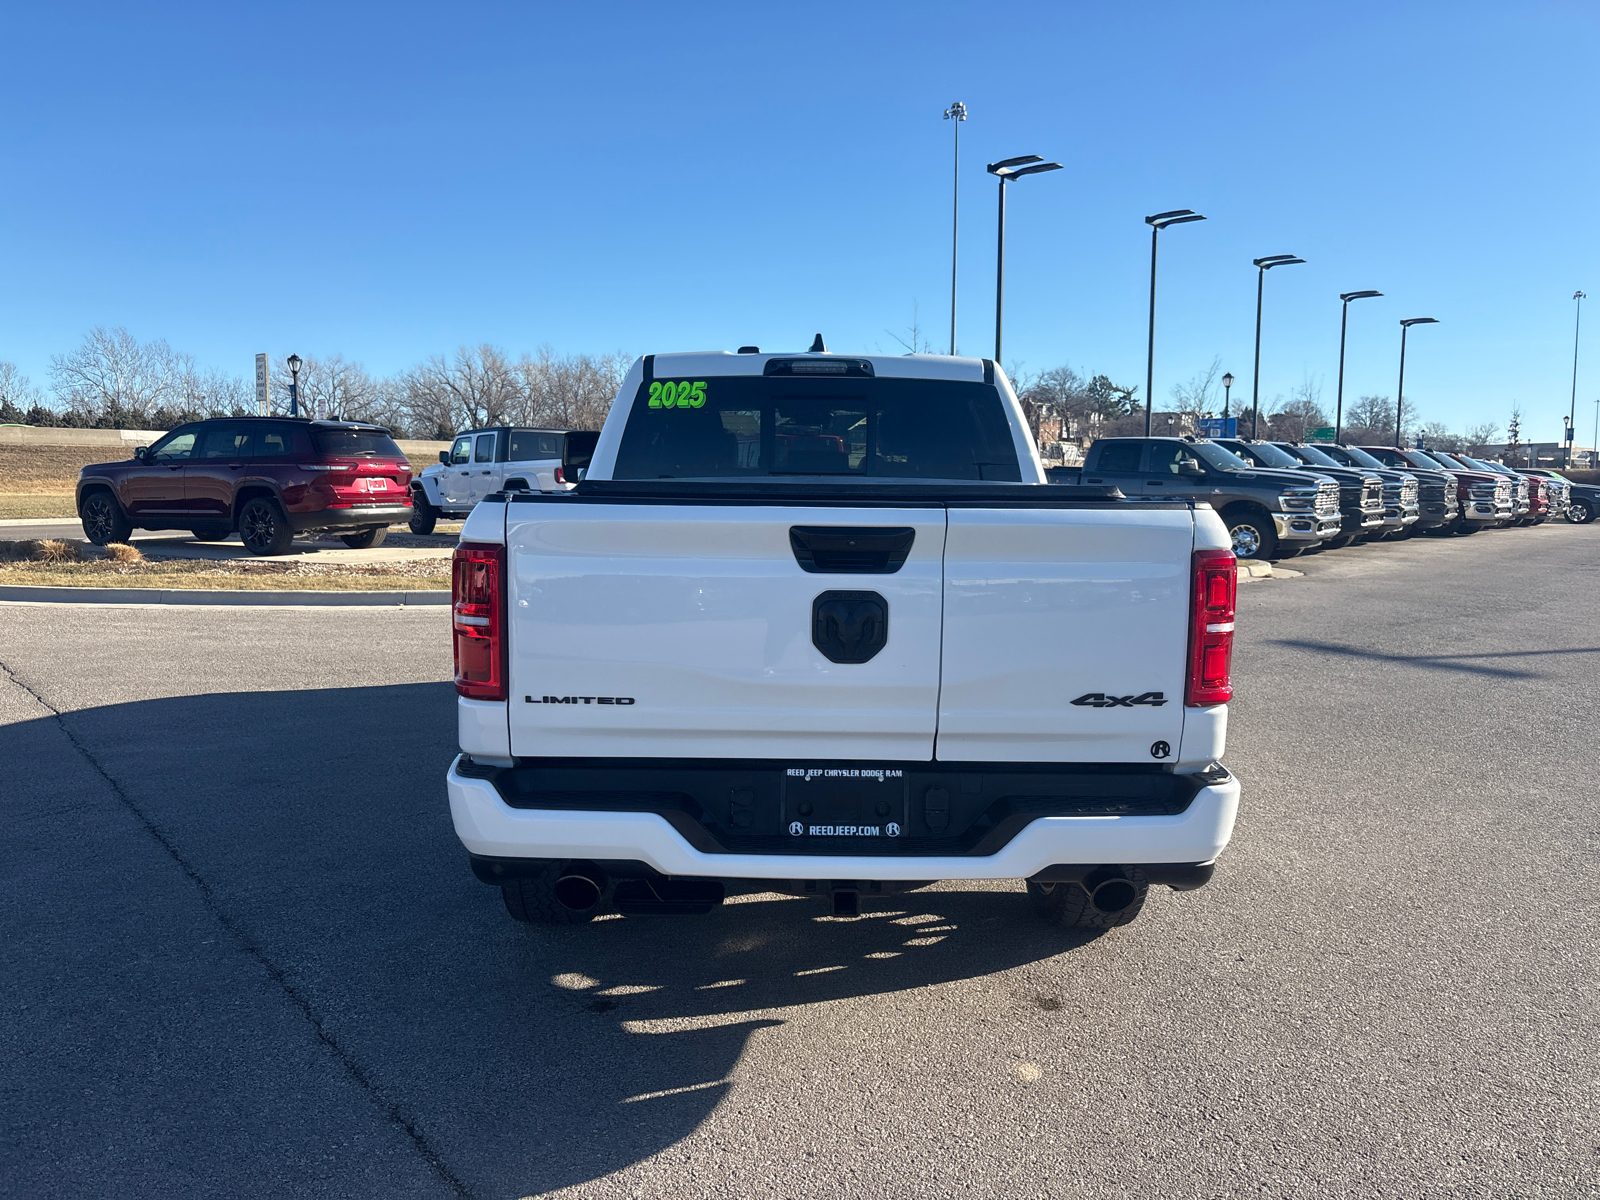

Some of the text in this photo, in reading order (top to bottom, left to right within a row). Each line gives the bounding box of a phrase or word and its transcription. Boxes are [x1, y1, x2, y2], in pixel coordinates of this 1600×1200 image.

[648, 381, 708, 409] 2025
[525, 695, 635, 705] LIMITED
[1069, 692, 1168, 707] 4x4
[786, 768, 804, 776] REED
[807, 769, 823, 777] JEEP
[824, 769, 860, 777] CHRYSLER
[809, 825, 880, 836] REEDJEEP.COM
